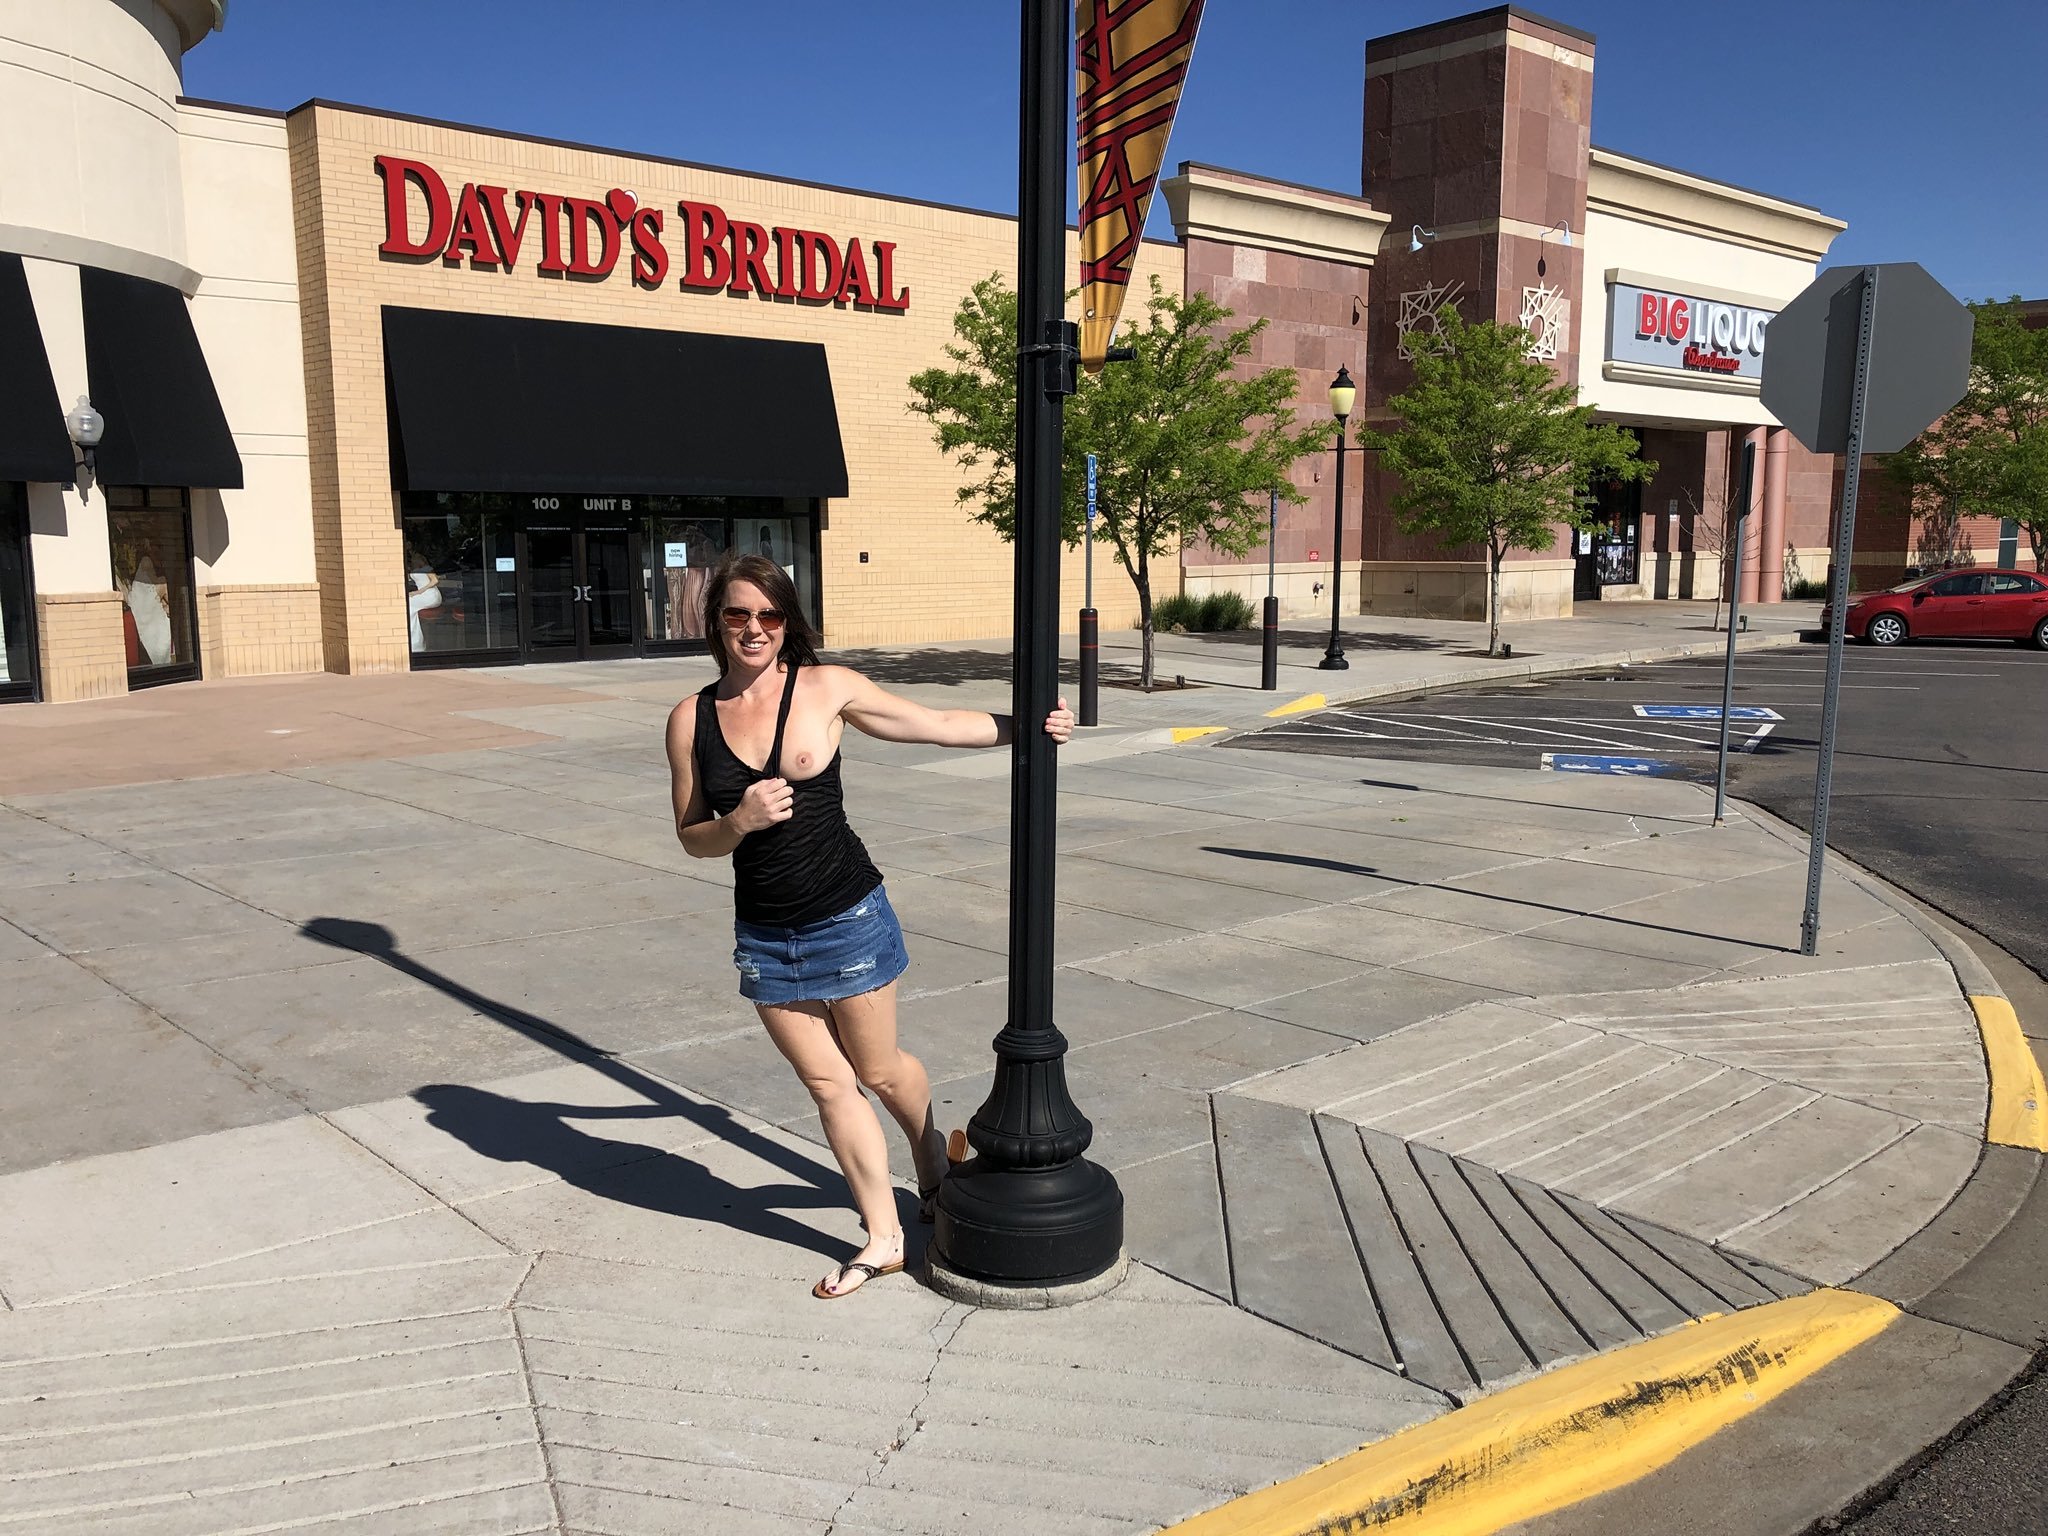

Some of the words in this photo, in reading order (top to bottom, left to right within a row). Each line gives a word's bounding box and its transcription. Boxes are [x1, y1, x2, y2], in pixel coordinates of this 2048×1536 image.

[375, 154, 669, 285] DAVID'S
[678, 200, 910, 310] BRIDAL
[1639, 293, 1690, 340] BIG
[1694, 301, 1769, 353] LIQUO
[532, 497, 560, 510] 100
[583, 498, 617, 511] UNIT
[621, 499, 632, 511] B
